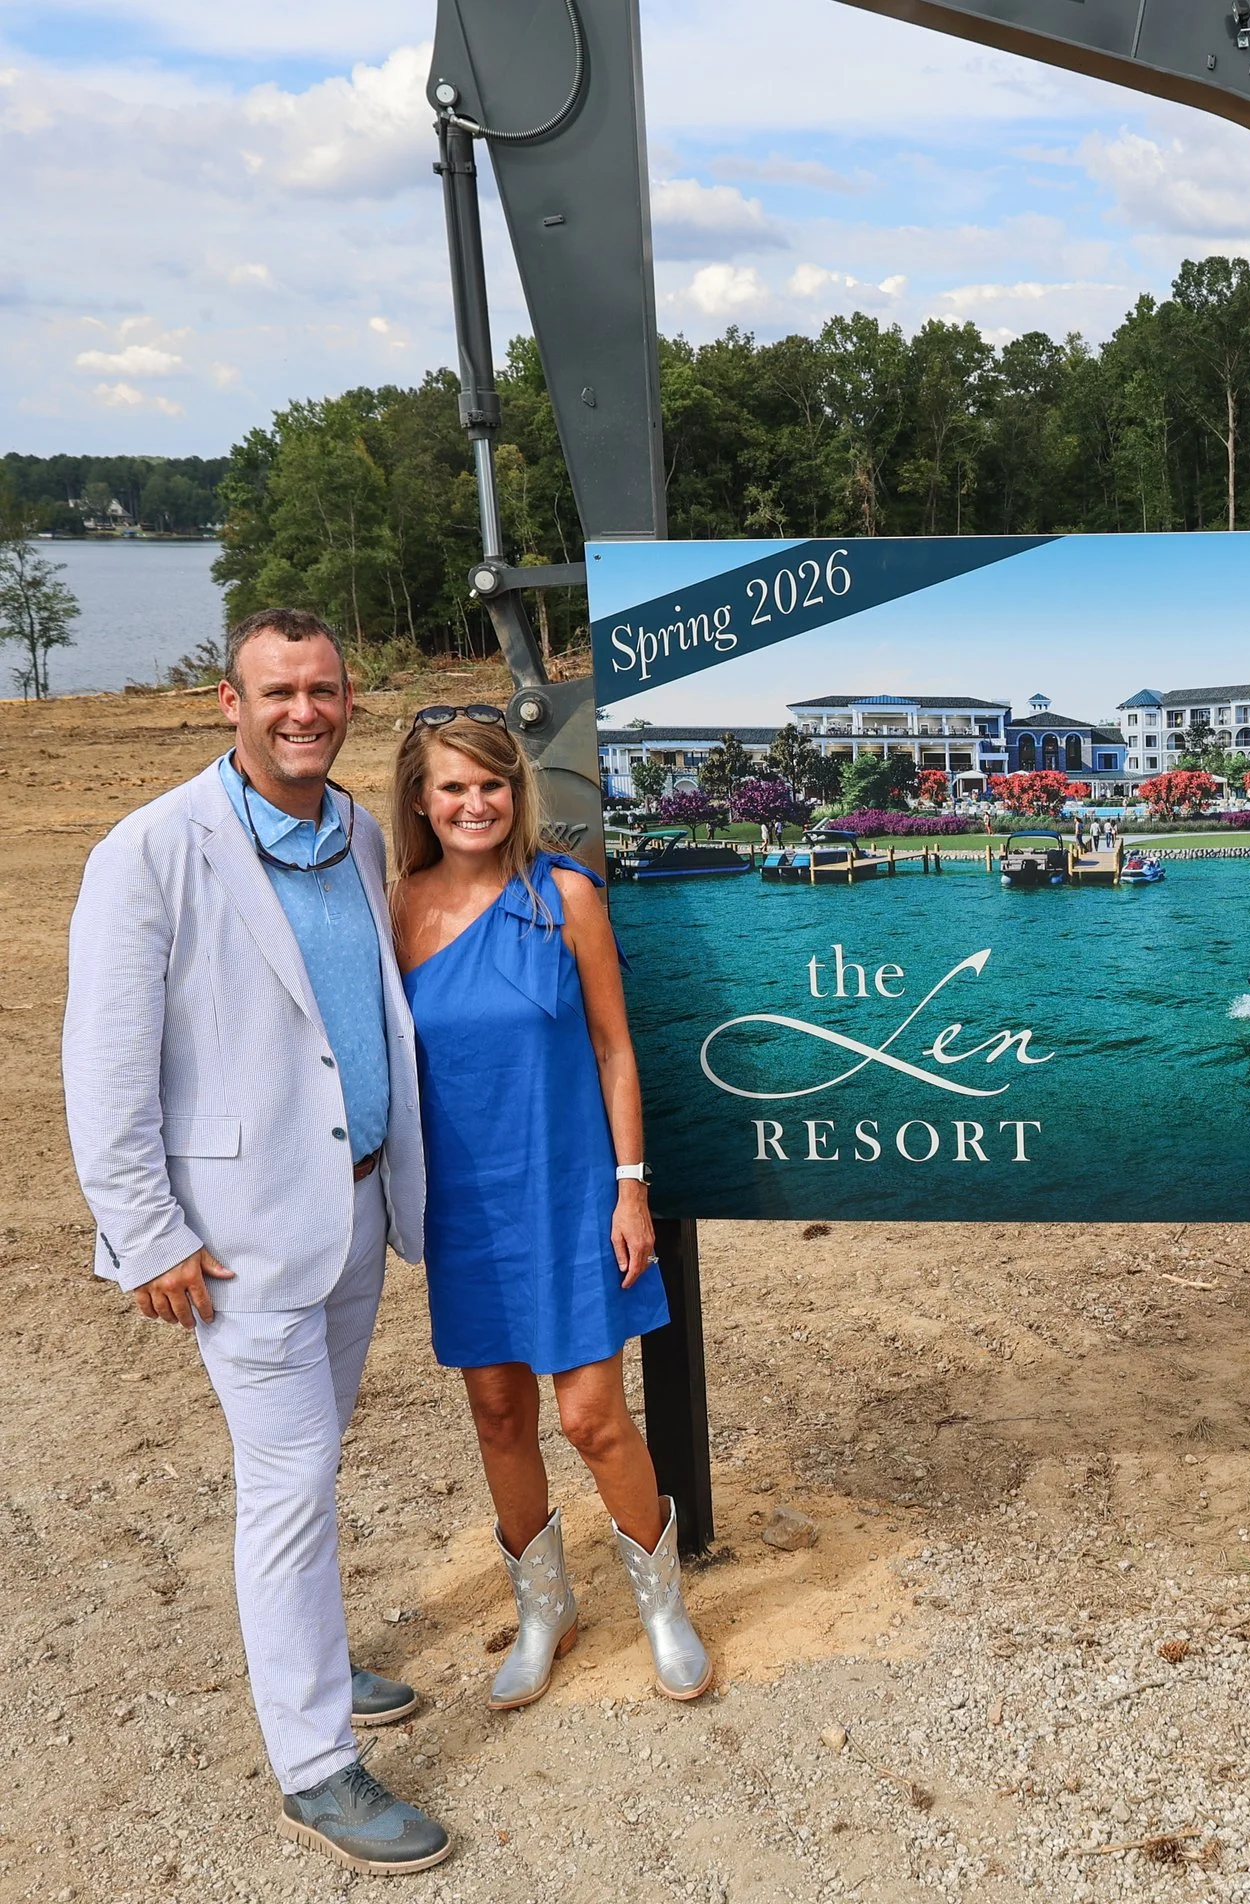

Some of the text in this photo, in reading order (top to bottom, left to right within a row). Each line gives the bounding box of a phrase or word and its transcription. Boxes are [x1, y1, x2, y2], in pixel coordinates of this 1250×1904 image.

[611, 548, 851, 681] Spring 2026
[805, 943, 906, 998] the
[751, 1119, 1042, 1163] RESORT
